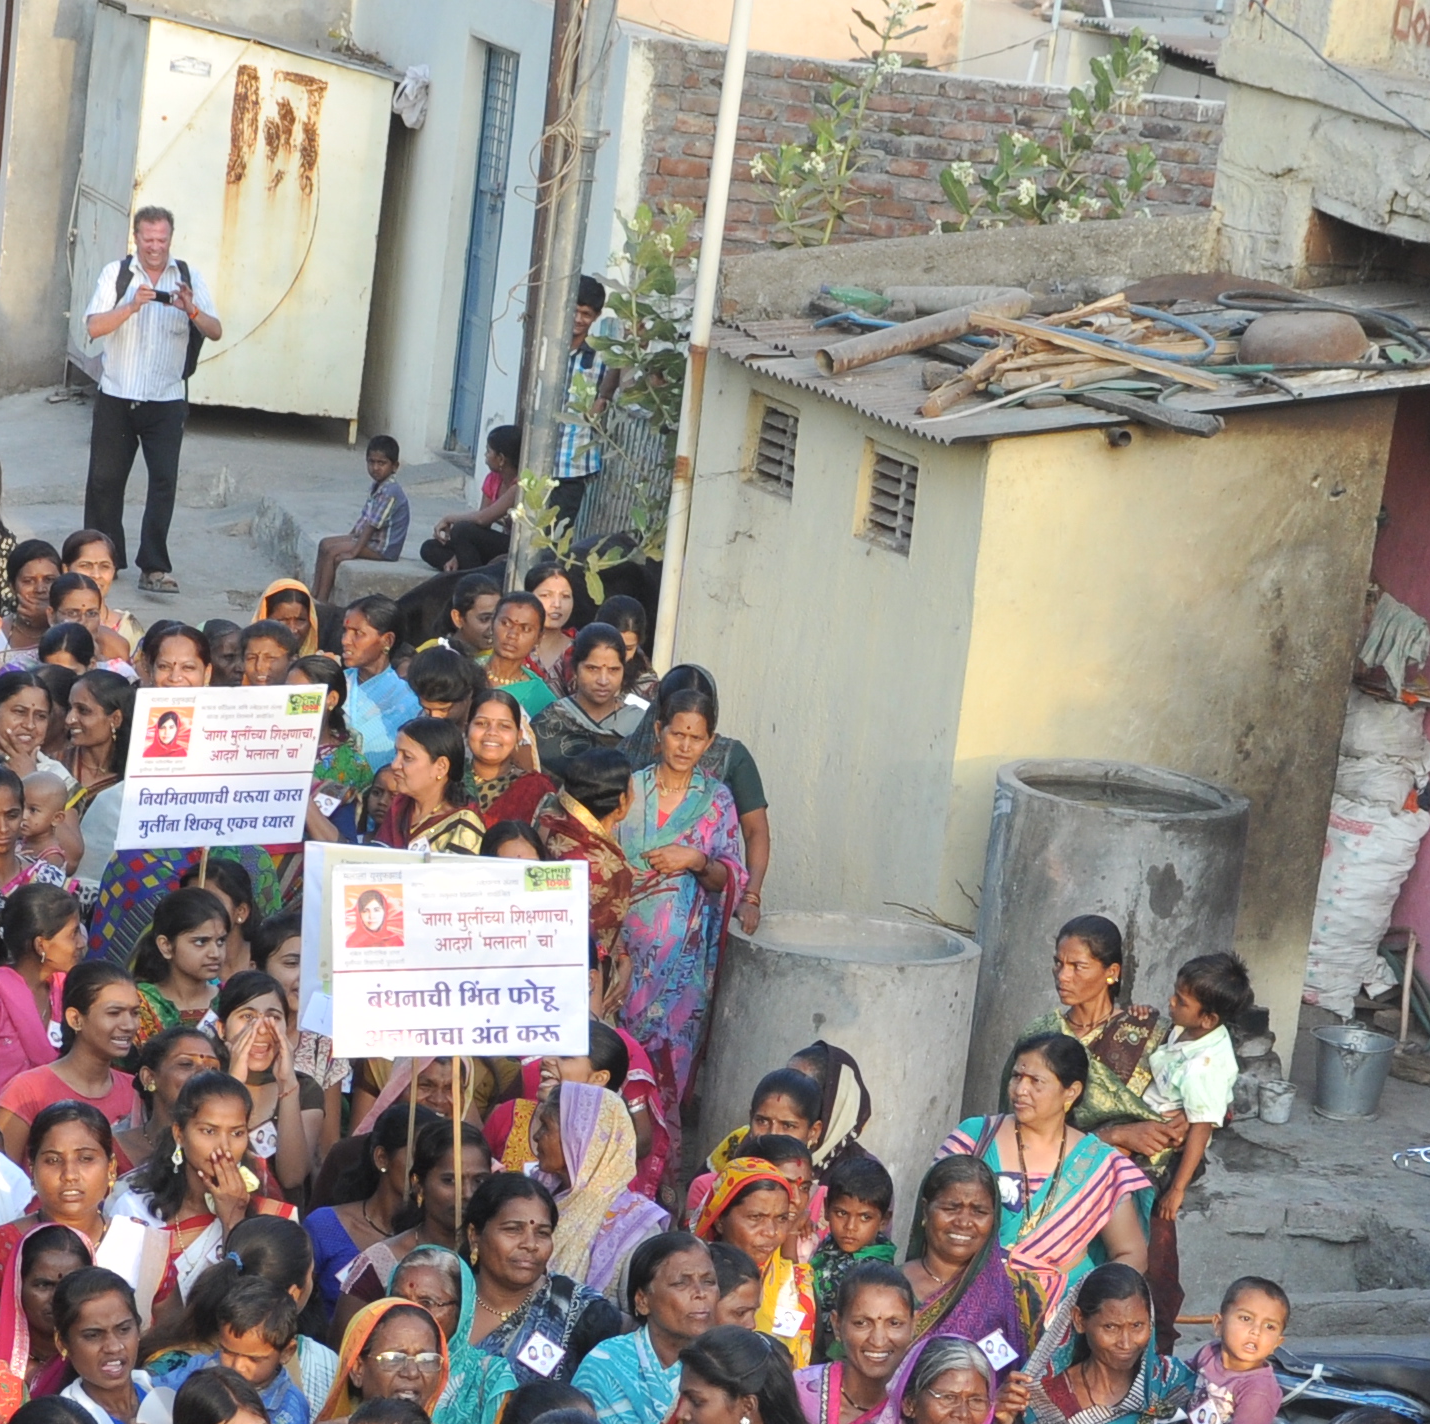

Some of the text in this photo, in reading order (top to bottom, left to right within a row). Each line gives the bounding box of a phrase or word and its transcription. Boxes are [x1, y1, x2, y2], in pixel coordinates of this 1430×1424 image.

[138, 786, 229, 806] नियमितपणाची
[273, 788, 304, 802] कास
[227, 817, 259, 833] एकच
[367, 978, 560, 1012] बंधनाची भिंत फोडू
[472, 1018, 508, 1044] अंत
